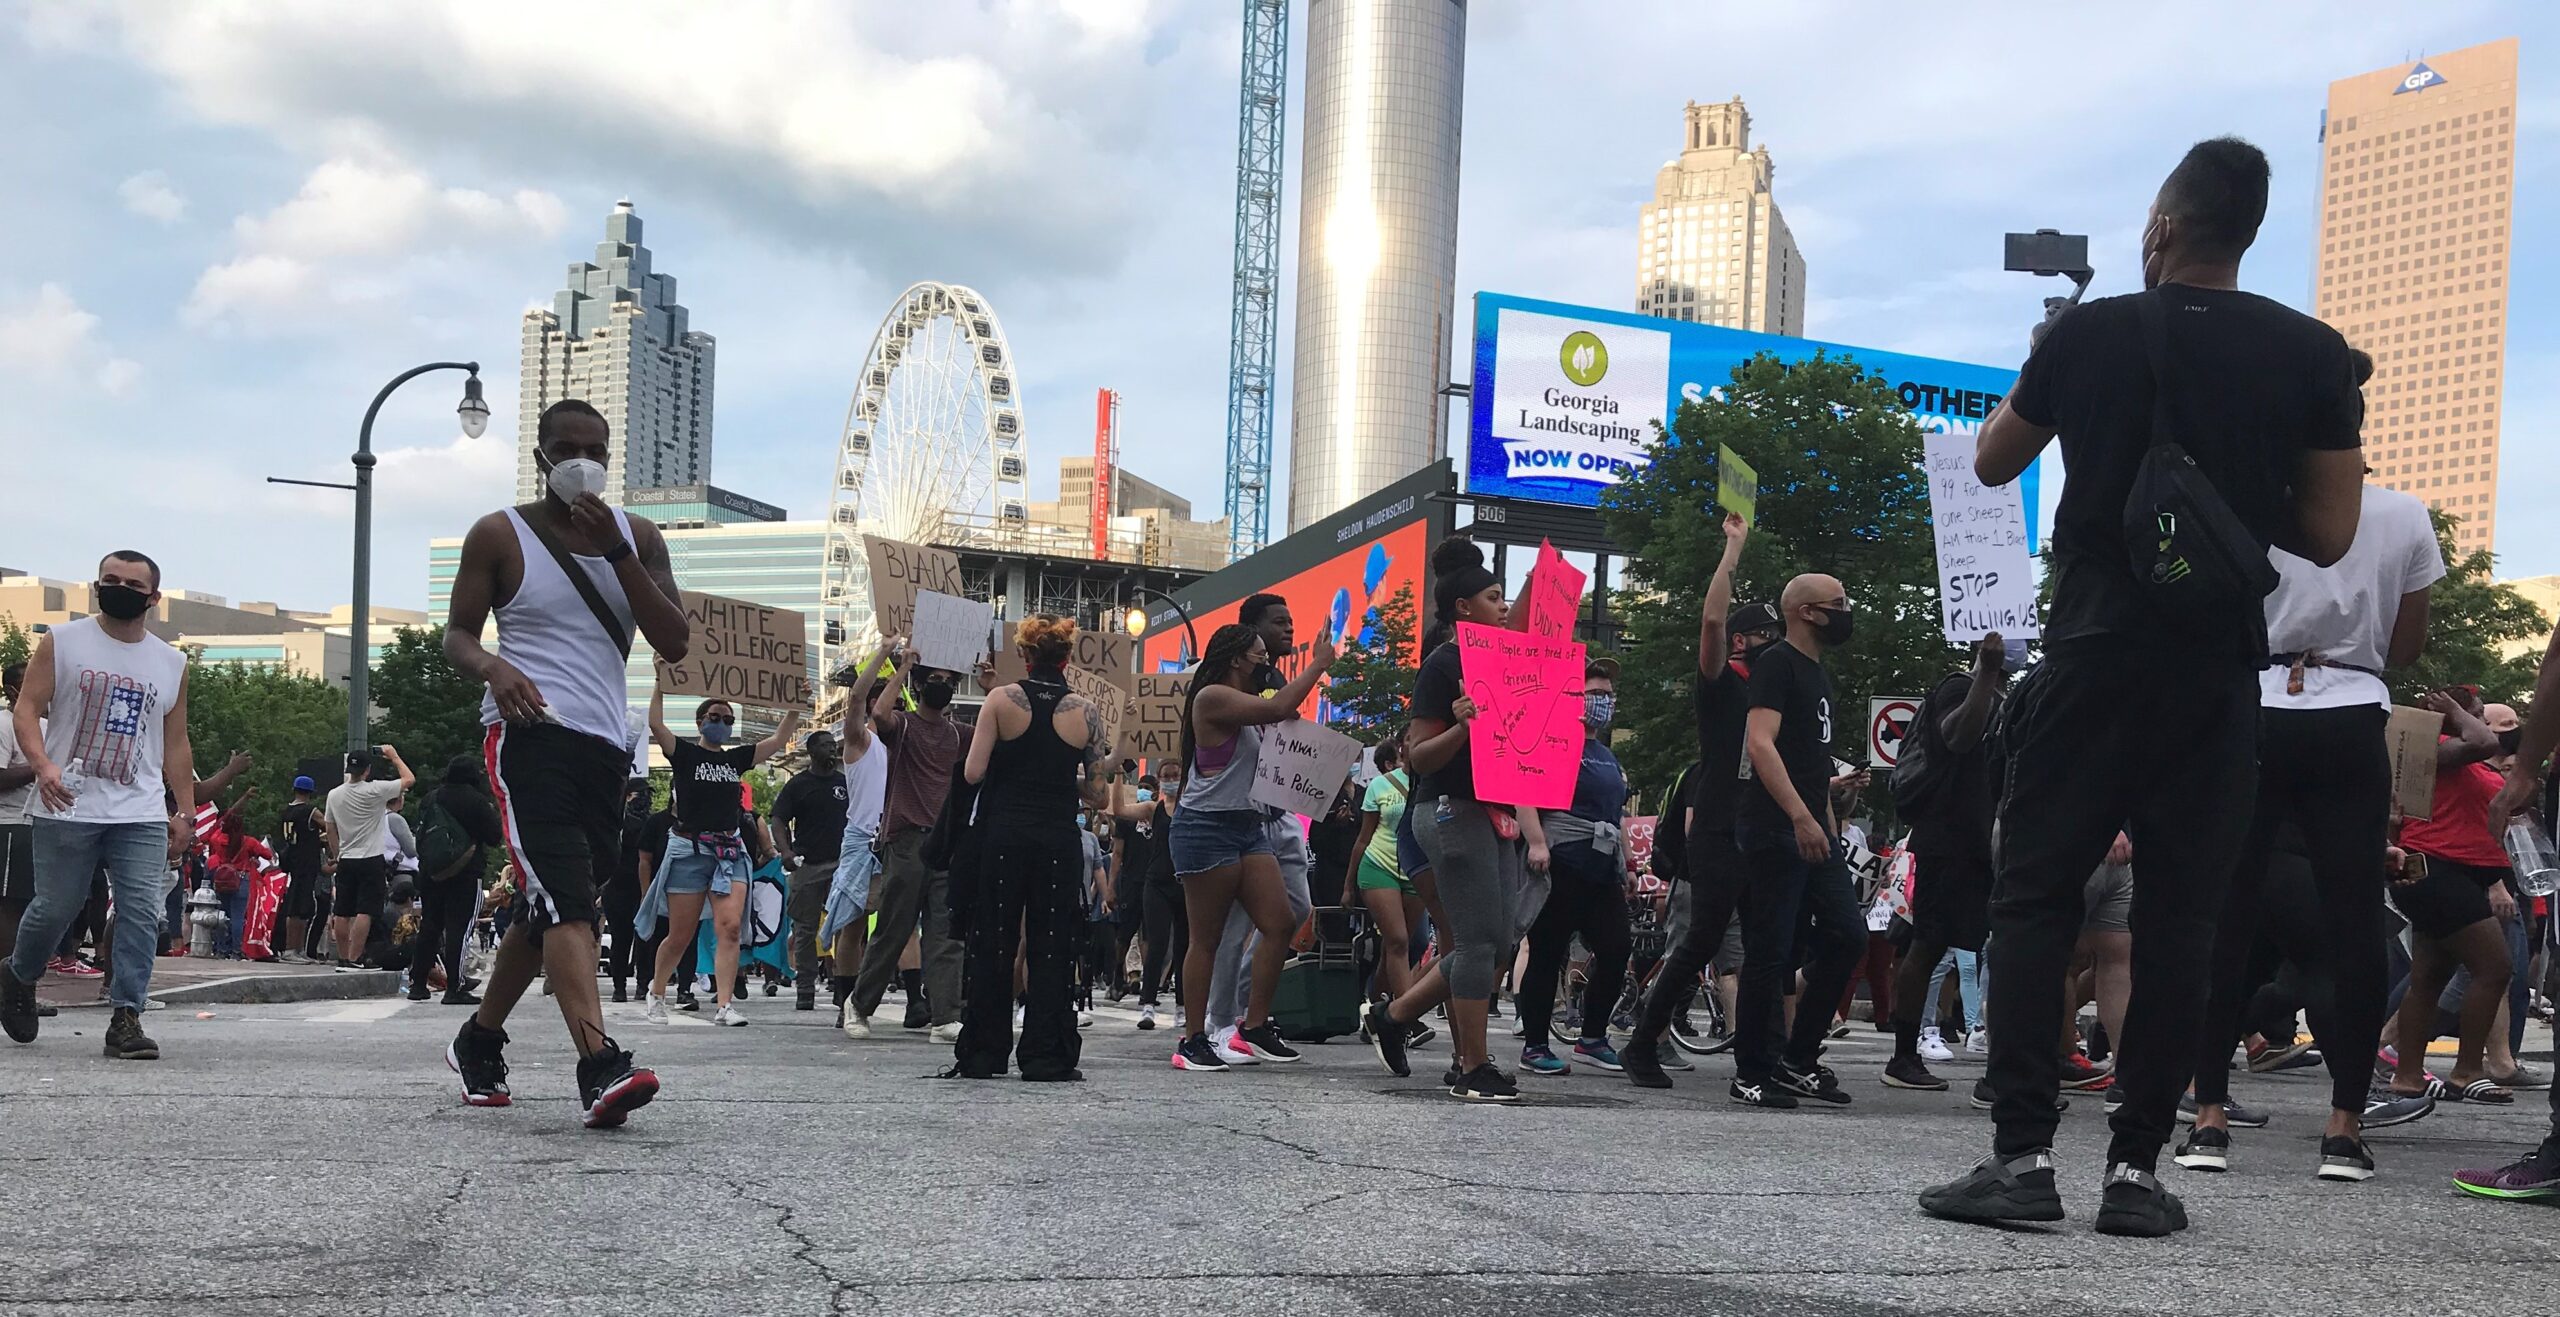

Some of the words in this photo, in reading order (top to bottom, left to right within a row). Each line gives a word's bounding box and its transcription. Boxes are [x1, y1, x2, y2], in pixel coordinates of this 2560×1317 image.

[2405, 71, 2434, 89] GP
[1544, 387, 1619, 417] Georgia
[1519, 409, 1641, 446] Landscaping
[1514, 449, 1572, 468] NOW
[1931, 452, 1966, 472] Jesus
[632, 490, 665, 502] Coastal
[669, 489, 697, 501] States
[724, 494, 750, 511] Coastal
[751, 503, 773, 519] States
[1479, 506, 1504, 521] 506
[1336, 519, 1363, 543] SHELDON
[1963, 529, 1989, 545] that
[879, 542, 961, 596] BLACK
[1950, 572, 1999, 603] STOP
[687, 599, 775, 637] WHITE
[2018, 601, 2037, 628] US
[704, 627, 804, 666] SILENCE
[1465, 628, 1494, 649] Black
[1498, 638, 1522, 660] People
[1525, 647, 1539, 657] are
[1545, 646, 1562, 660] tired
[1565, 648, 1577, 661] of
[668, 664, 689, 686] IS
[699, 660, 809, 705] VIOLENCE
[1087, 676, 1116, 706] COPS
[1502, 665, 1543, 693] Grieving!
[1290, 773, 1326, 800] Police
